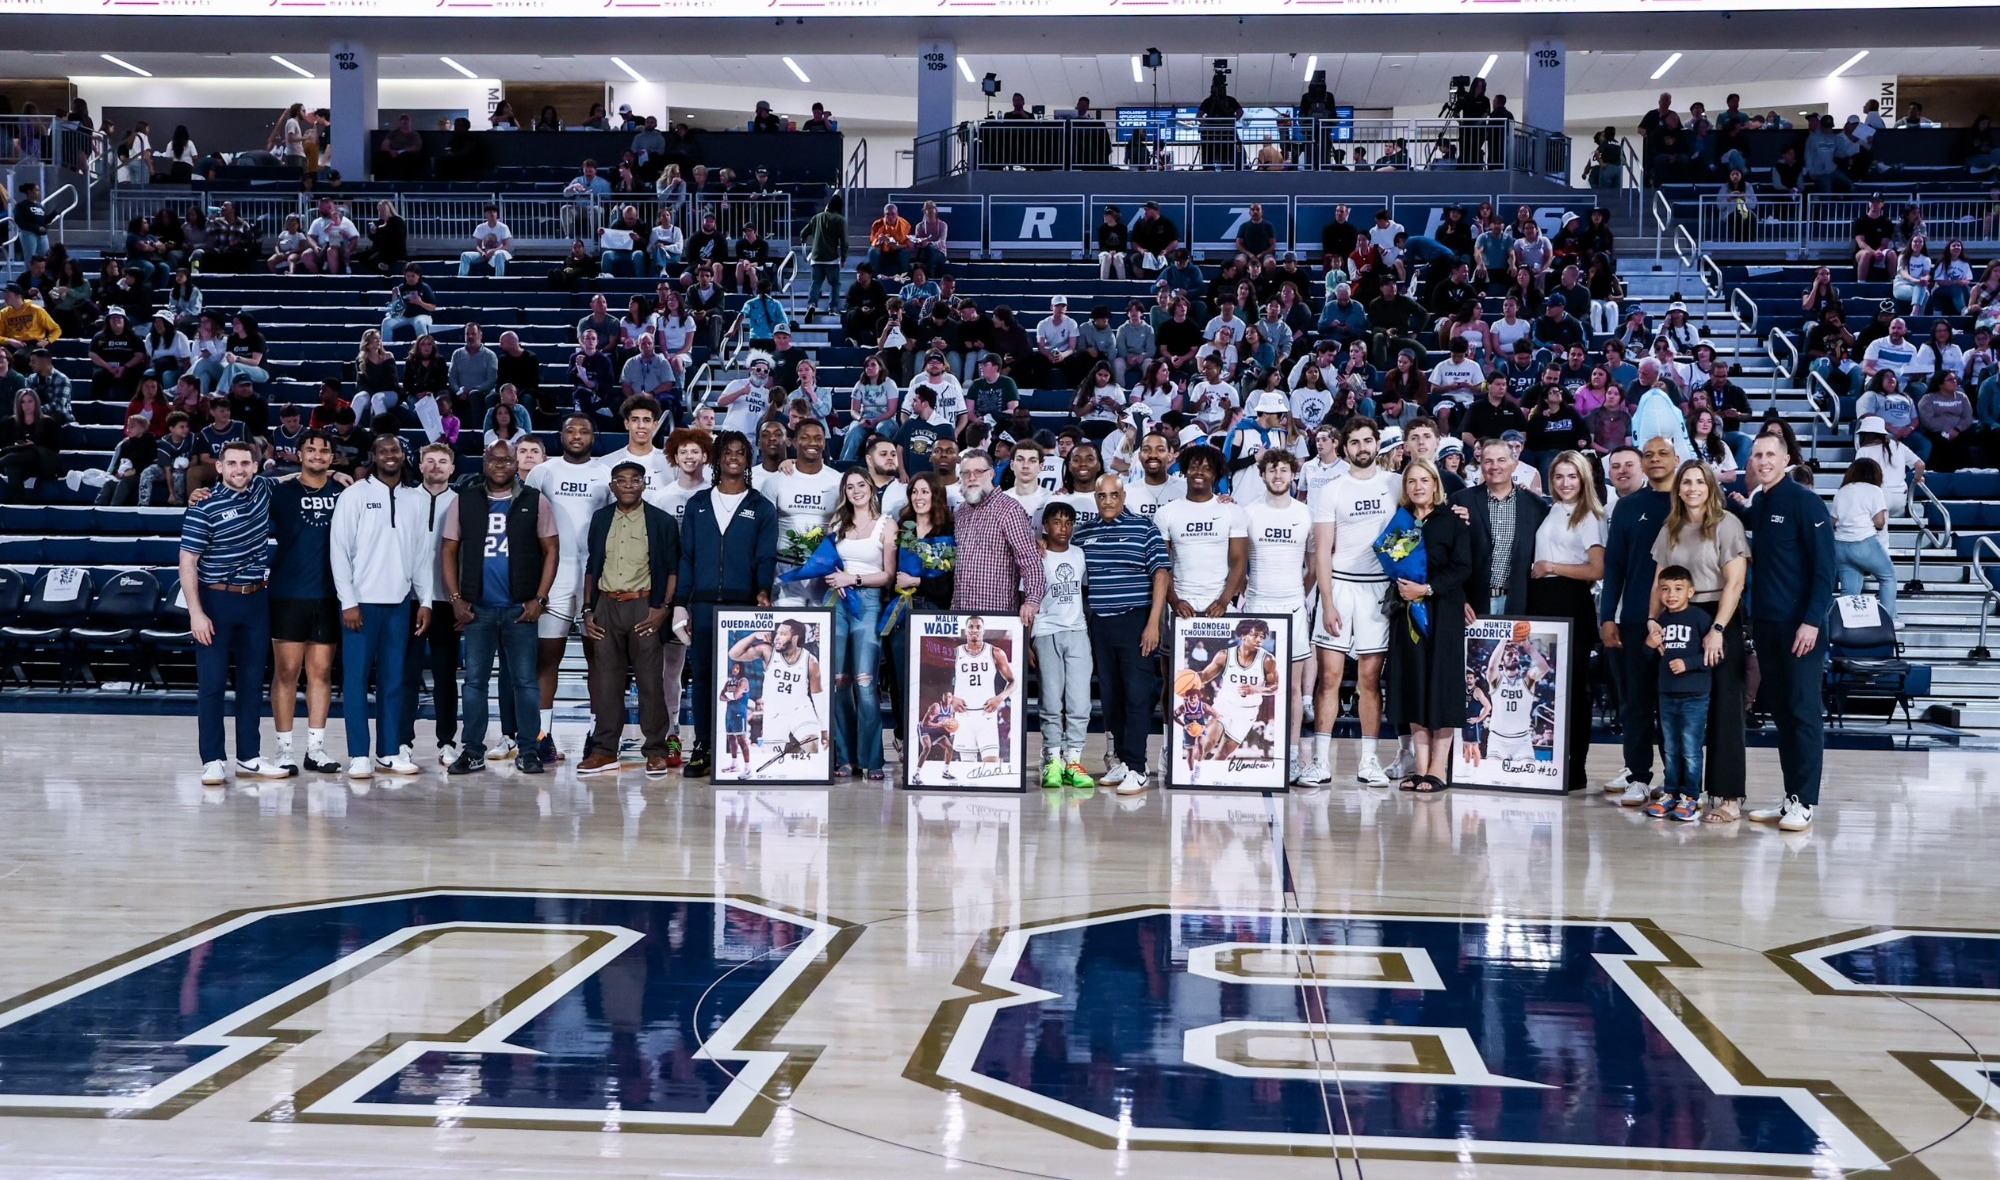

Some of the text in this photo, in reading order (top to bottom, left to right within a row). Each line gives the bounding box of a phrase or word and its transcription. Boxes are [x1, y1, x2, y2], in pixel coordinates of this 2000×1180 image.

[340, 53, 354, 61] 107
[928, 53, 944, 61] 108
[1539, 50, 1556, 58] 109
[339, 62, 354, 70] 108
[1881, 82, 1894, 118] MEN
[745, 396, 766, 407] LANCE
[748, 404, 761, 413] UP
[560, 482, 588, 492] CBU
[301, 497, 335, 509] CBU
[794, 494, 821, 505] CBU
[1355, 499, 1381, 511] CBU
[221, 509, 238, 520] CBU
[1140, 504, 1161, 514] CB
[1350, 509, 1386, 517] BASKETBALL
[1771, 514, 1784, 523] CBU
[1186, 522, 1213, 532] CBU
[1264, 528, 1292, 539] CBU
[483, 536, 509, 557] 24
[721, 620, 774, 629] OUEDRAOGO
[924, 622, 959, 635] WADE
[1193, 622, 1231, 630] BLONDEAU
[1484, 621, 1512, 629] HUNTER
[1464, 628, 1511, 638] GOODRICK
[1662, 624, 1691, 642] BU
[961, 662, 989, 673] CBU
[773, 668, 801, 683] CBU
[969, 674, 982, 686] 21
[1230, 674, 1258, 685] CBU
[777, 682, 793, 694] 24
[1501, 688, 1523, 699] CBU
[1506, 701, 1517, 712] 10
[1538, 766, 1558, 777] #10
